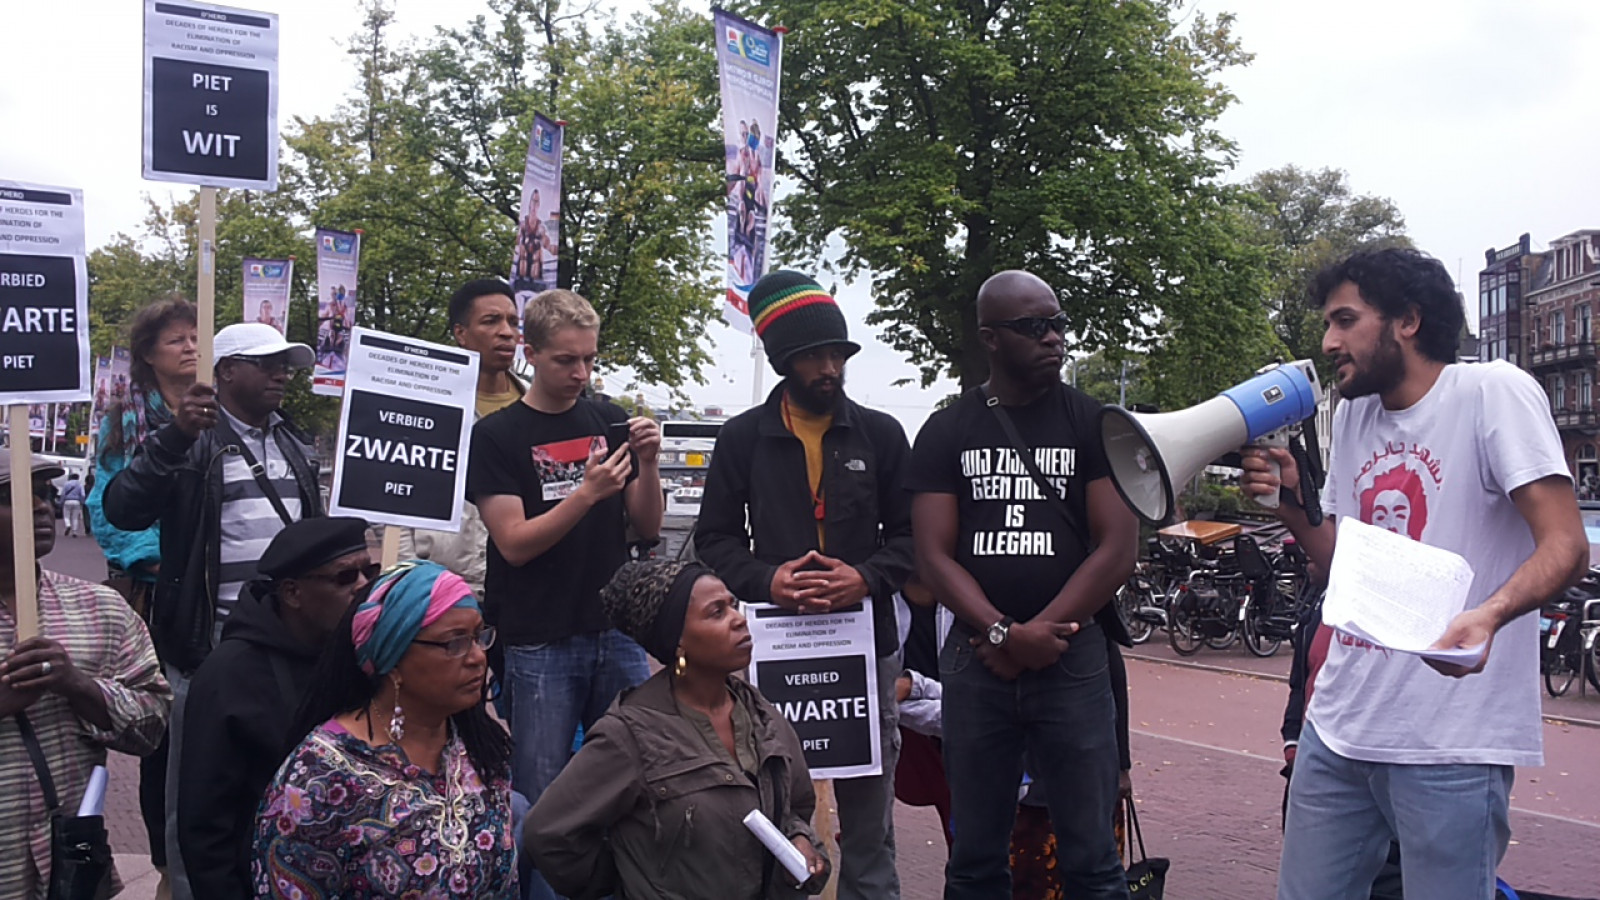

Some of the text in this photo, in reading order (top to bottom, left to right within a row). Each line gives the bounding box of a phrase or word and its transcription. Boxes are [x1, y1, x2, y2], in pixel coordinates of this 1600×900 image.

[165, 19, 196, 30] DECADES
[208, 25, 233, 35] HEROES
[234, 29, 248, 37] FOR
[186, 33, 231, 45] ELIMINATION
[171, 43, 256, 59] RACISM AND OPPRESSION
[192, 72, 232, 92] PIET
[206, 104, 218, 116] IS
[182, 130, 241, 158] WIT
[34, 209, 49, 217] FOR
[50, 210, 64, 218] THE
[33, 221, 43, 229] OF
[14, 234, 60, 244] OPPRESSION
[0, 272, 46, 287] RBIED
[0, 306, 75, 333] ARTE
[404, 345, 429, 356] D'HERO
[3, 354, 35, 369] PIET
[368, 352, 398, 364] DECADES
[409, 360, 434, 370] HEROES
[449, 367, 460, 375] THE
[387, 366, 430, 380] ELIMINATION
[371, 375, 453, 396] RACISM AND OPPRESSION
[379, 409, 435, 430] VERBIED
[346, 434, 456, 471] ZWARTE
[960, 448, 991, 477] WIJ
[1034, 448, 1076, 476] HIER!
[384, 481, 414, 496] PIET
[971, 476, 1011, 500] GEEN
[1005, 504, 1025, 528] IS
[973, 531, 1055, 556] ILLEGAAL
[765, 621, 794, 629] DECADES
[804, 619, 829, 627] HEROES
[785, 629, 827, 638] ELIMINATION
[813, 640, 852, 648] OPPRESSION
[784, 671, 840, 686] VERBIED
[770, 696, 867, 722] WARTE
[803, 738, 830, 751] PIET
